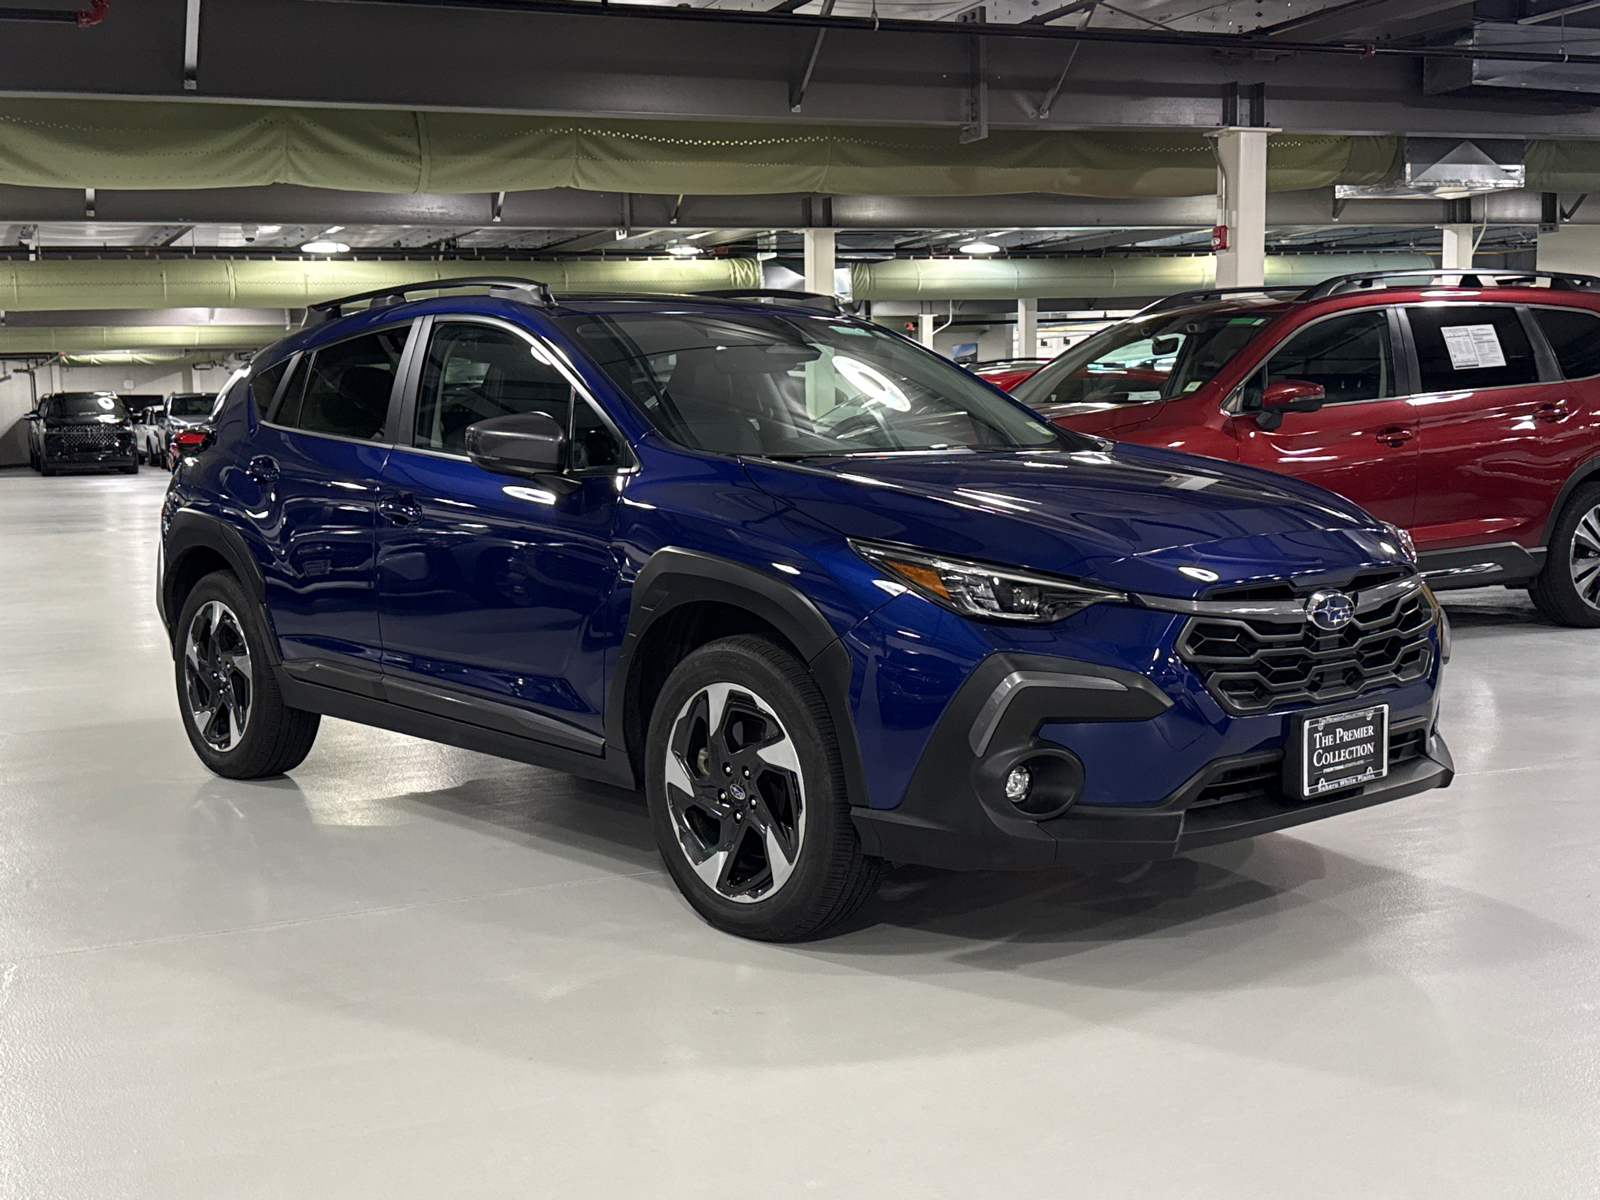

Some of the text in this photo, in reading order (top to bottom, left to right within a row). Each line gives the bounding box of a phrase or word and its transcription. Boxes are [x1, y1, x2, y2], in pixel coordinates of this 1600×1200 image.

[1313, 725, 1375, 749] THE PREMIER
[1313, 742, 1375, 767] COLLECTION
